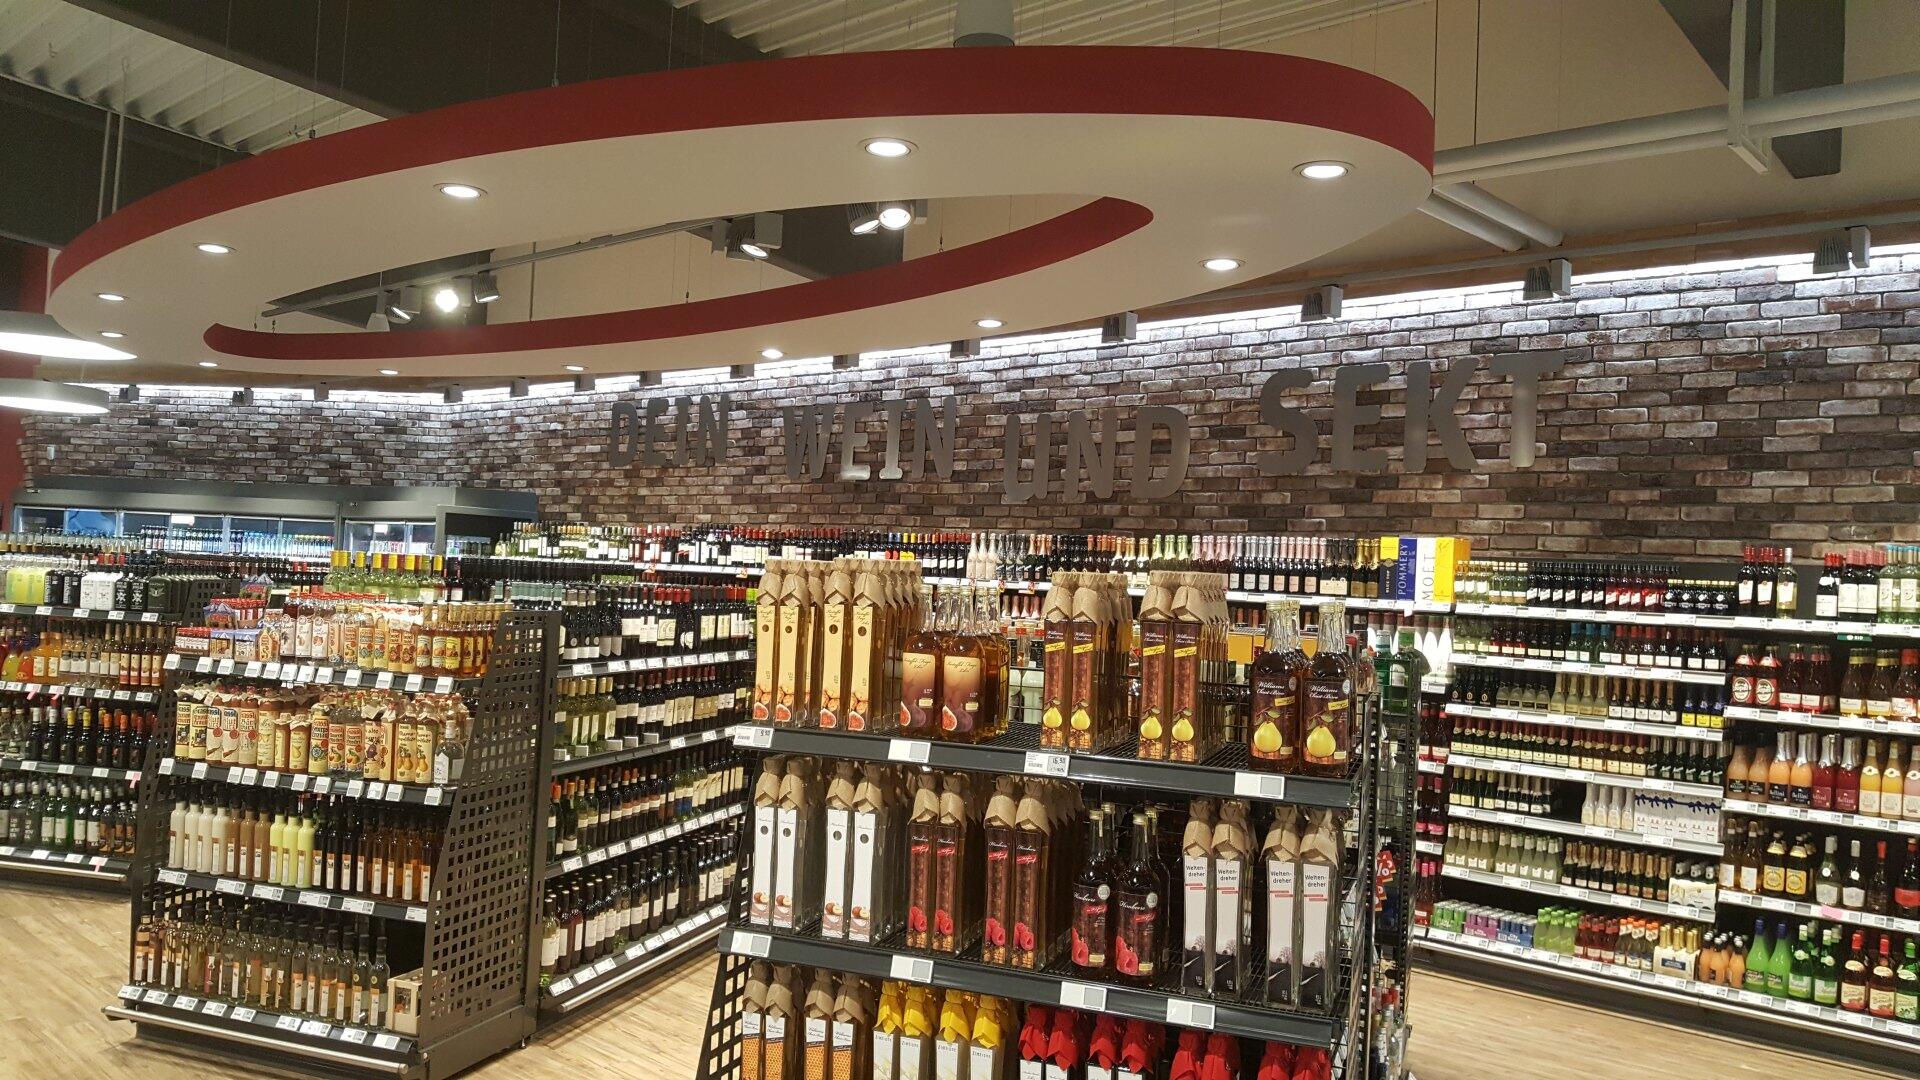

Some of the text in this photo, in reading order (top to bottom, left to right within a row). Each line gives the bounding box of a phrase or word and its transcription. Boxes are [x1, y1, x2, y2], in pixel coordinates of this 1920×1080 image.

[609, 351, 1565, 500] DEIN WEIN UND SEKT
[1397, 544, 1408, 596] POMMERY
[1307, 880, 1327, 888] dreher
